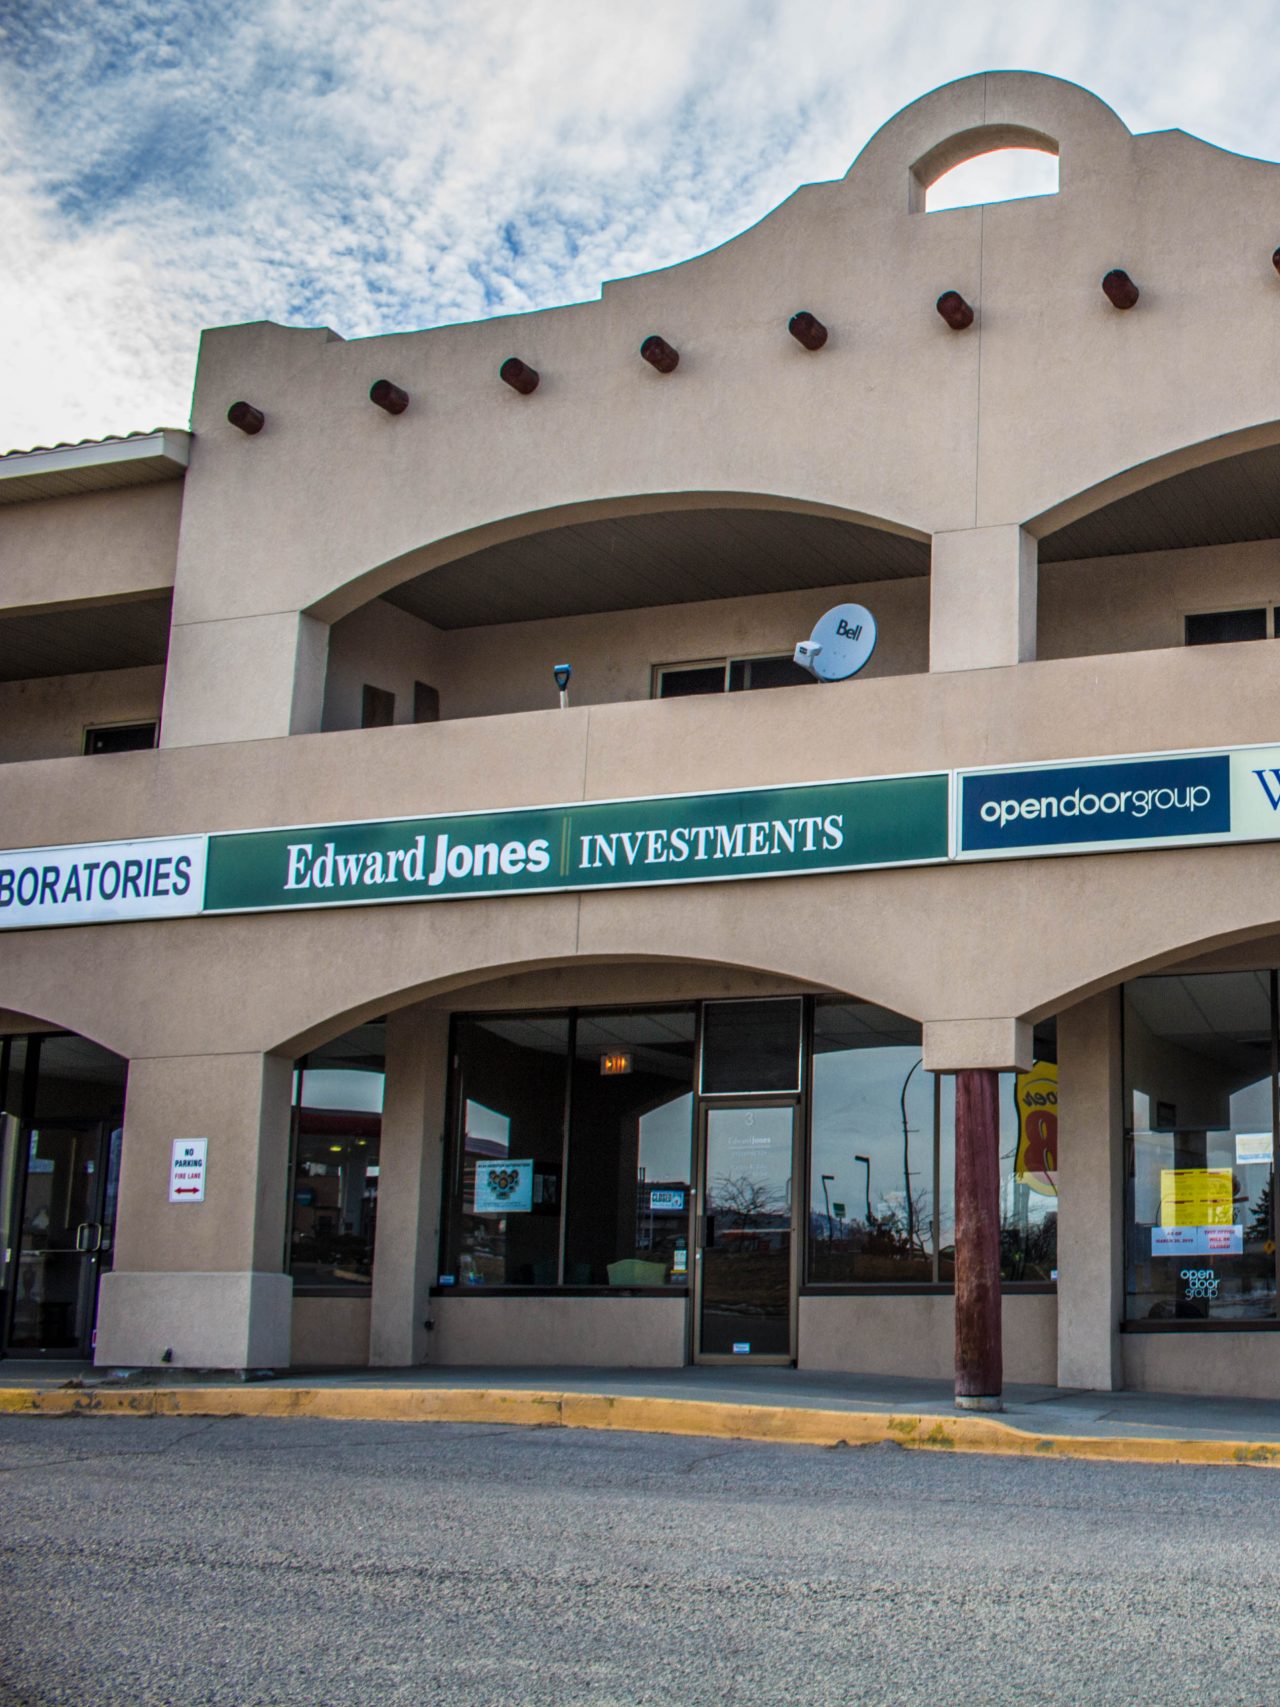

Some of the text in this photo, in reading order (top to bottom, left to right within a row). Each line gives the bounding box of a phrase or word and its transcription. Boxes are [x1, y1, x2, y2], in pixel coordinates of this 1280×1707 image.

[836, 618, 863, 642] Bell
[578, 815, 844, 869] INVESTMENTS
[284, 834, 550, 890] Edward Jones
[0, 855, 192, 908] BORATORIES
[745, 1111, 754, 1126] 3
[184, 1148, 194, 1156] NO
[174, 1159, 202, 1167] PARKING
[1180, 1269, 1214, 1280] open
[1190, 1277, 1220, 1289] door
[1184, 1288, 1218, 1300] group
